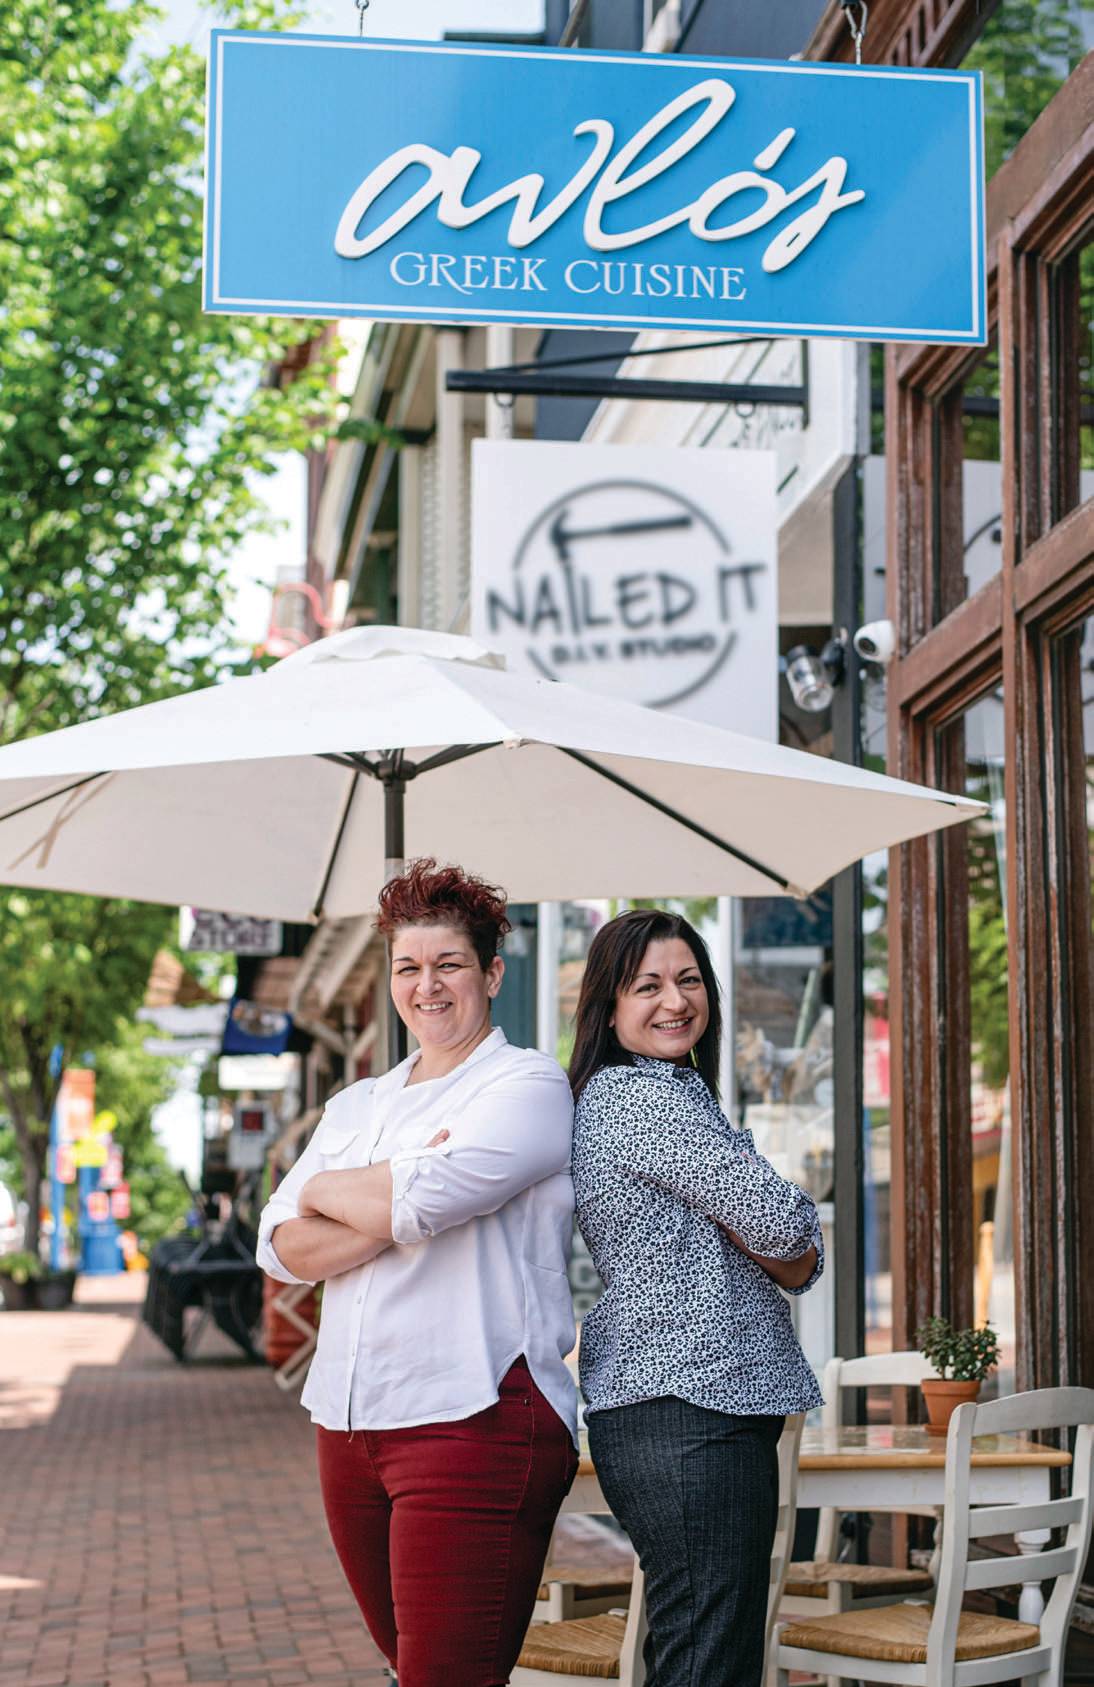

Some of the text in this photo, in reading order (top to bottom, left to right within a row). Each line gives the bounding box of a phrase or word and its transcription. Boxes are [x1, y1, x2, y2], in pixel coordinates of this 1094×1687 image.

[390, 252, 747, 300] GREEK CUISINE
[486, 562, 766, 635] NAILED IT
